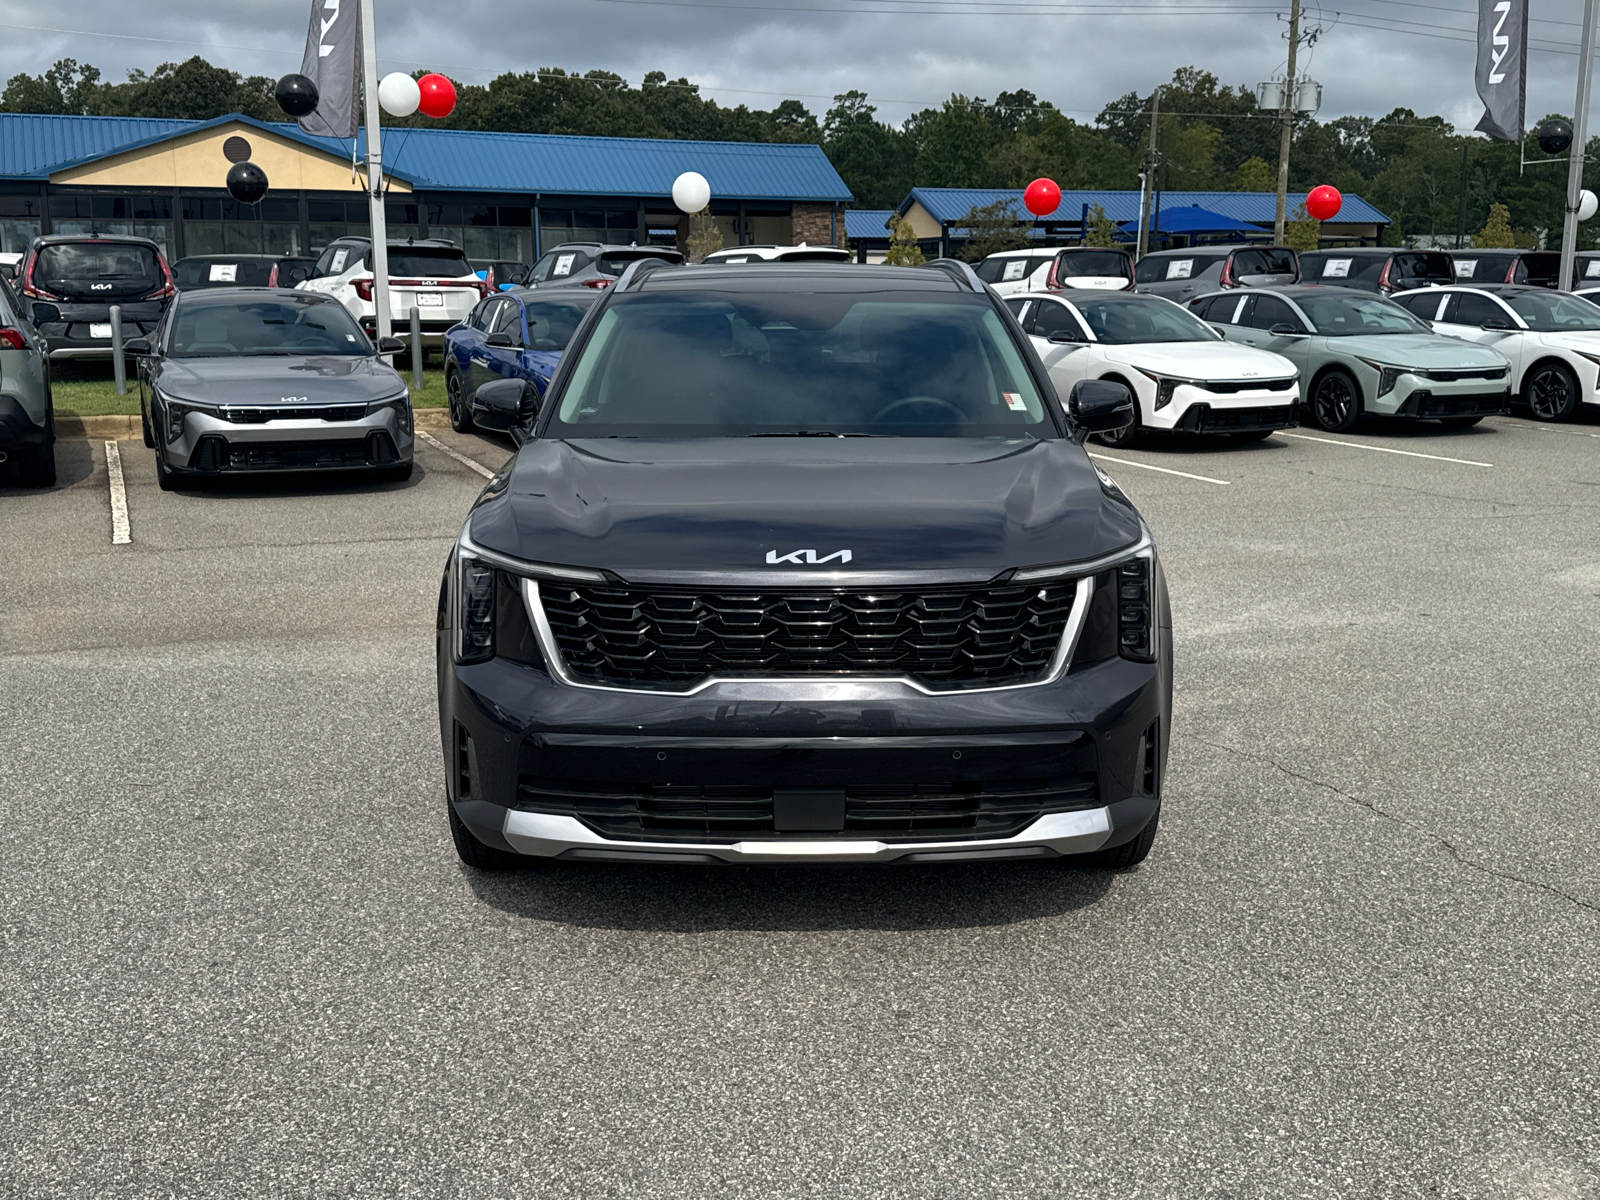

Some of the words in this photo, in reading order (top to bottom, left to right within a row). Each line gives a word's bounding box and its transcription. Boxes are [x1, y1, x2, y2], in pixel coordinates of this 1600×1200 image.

[319, 0, 340, 57] KI
[1488, 1, 1511, 85] KIA
[766, 549, 853, 565] KIA
